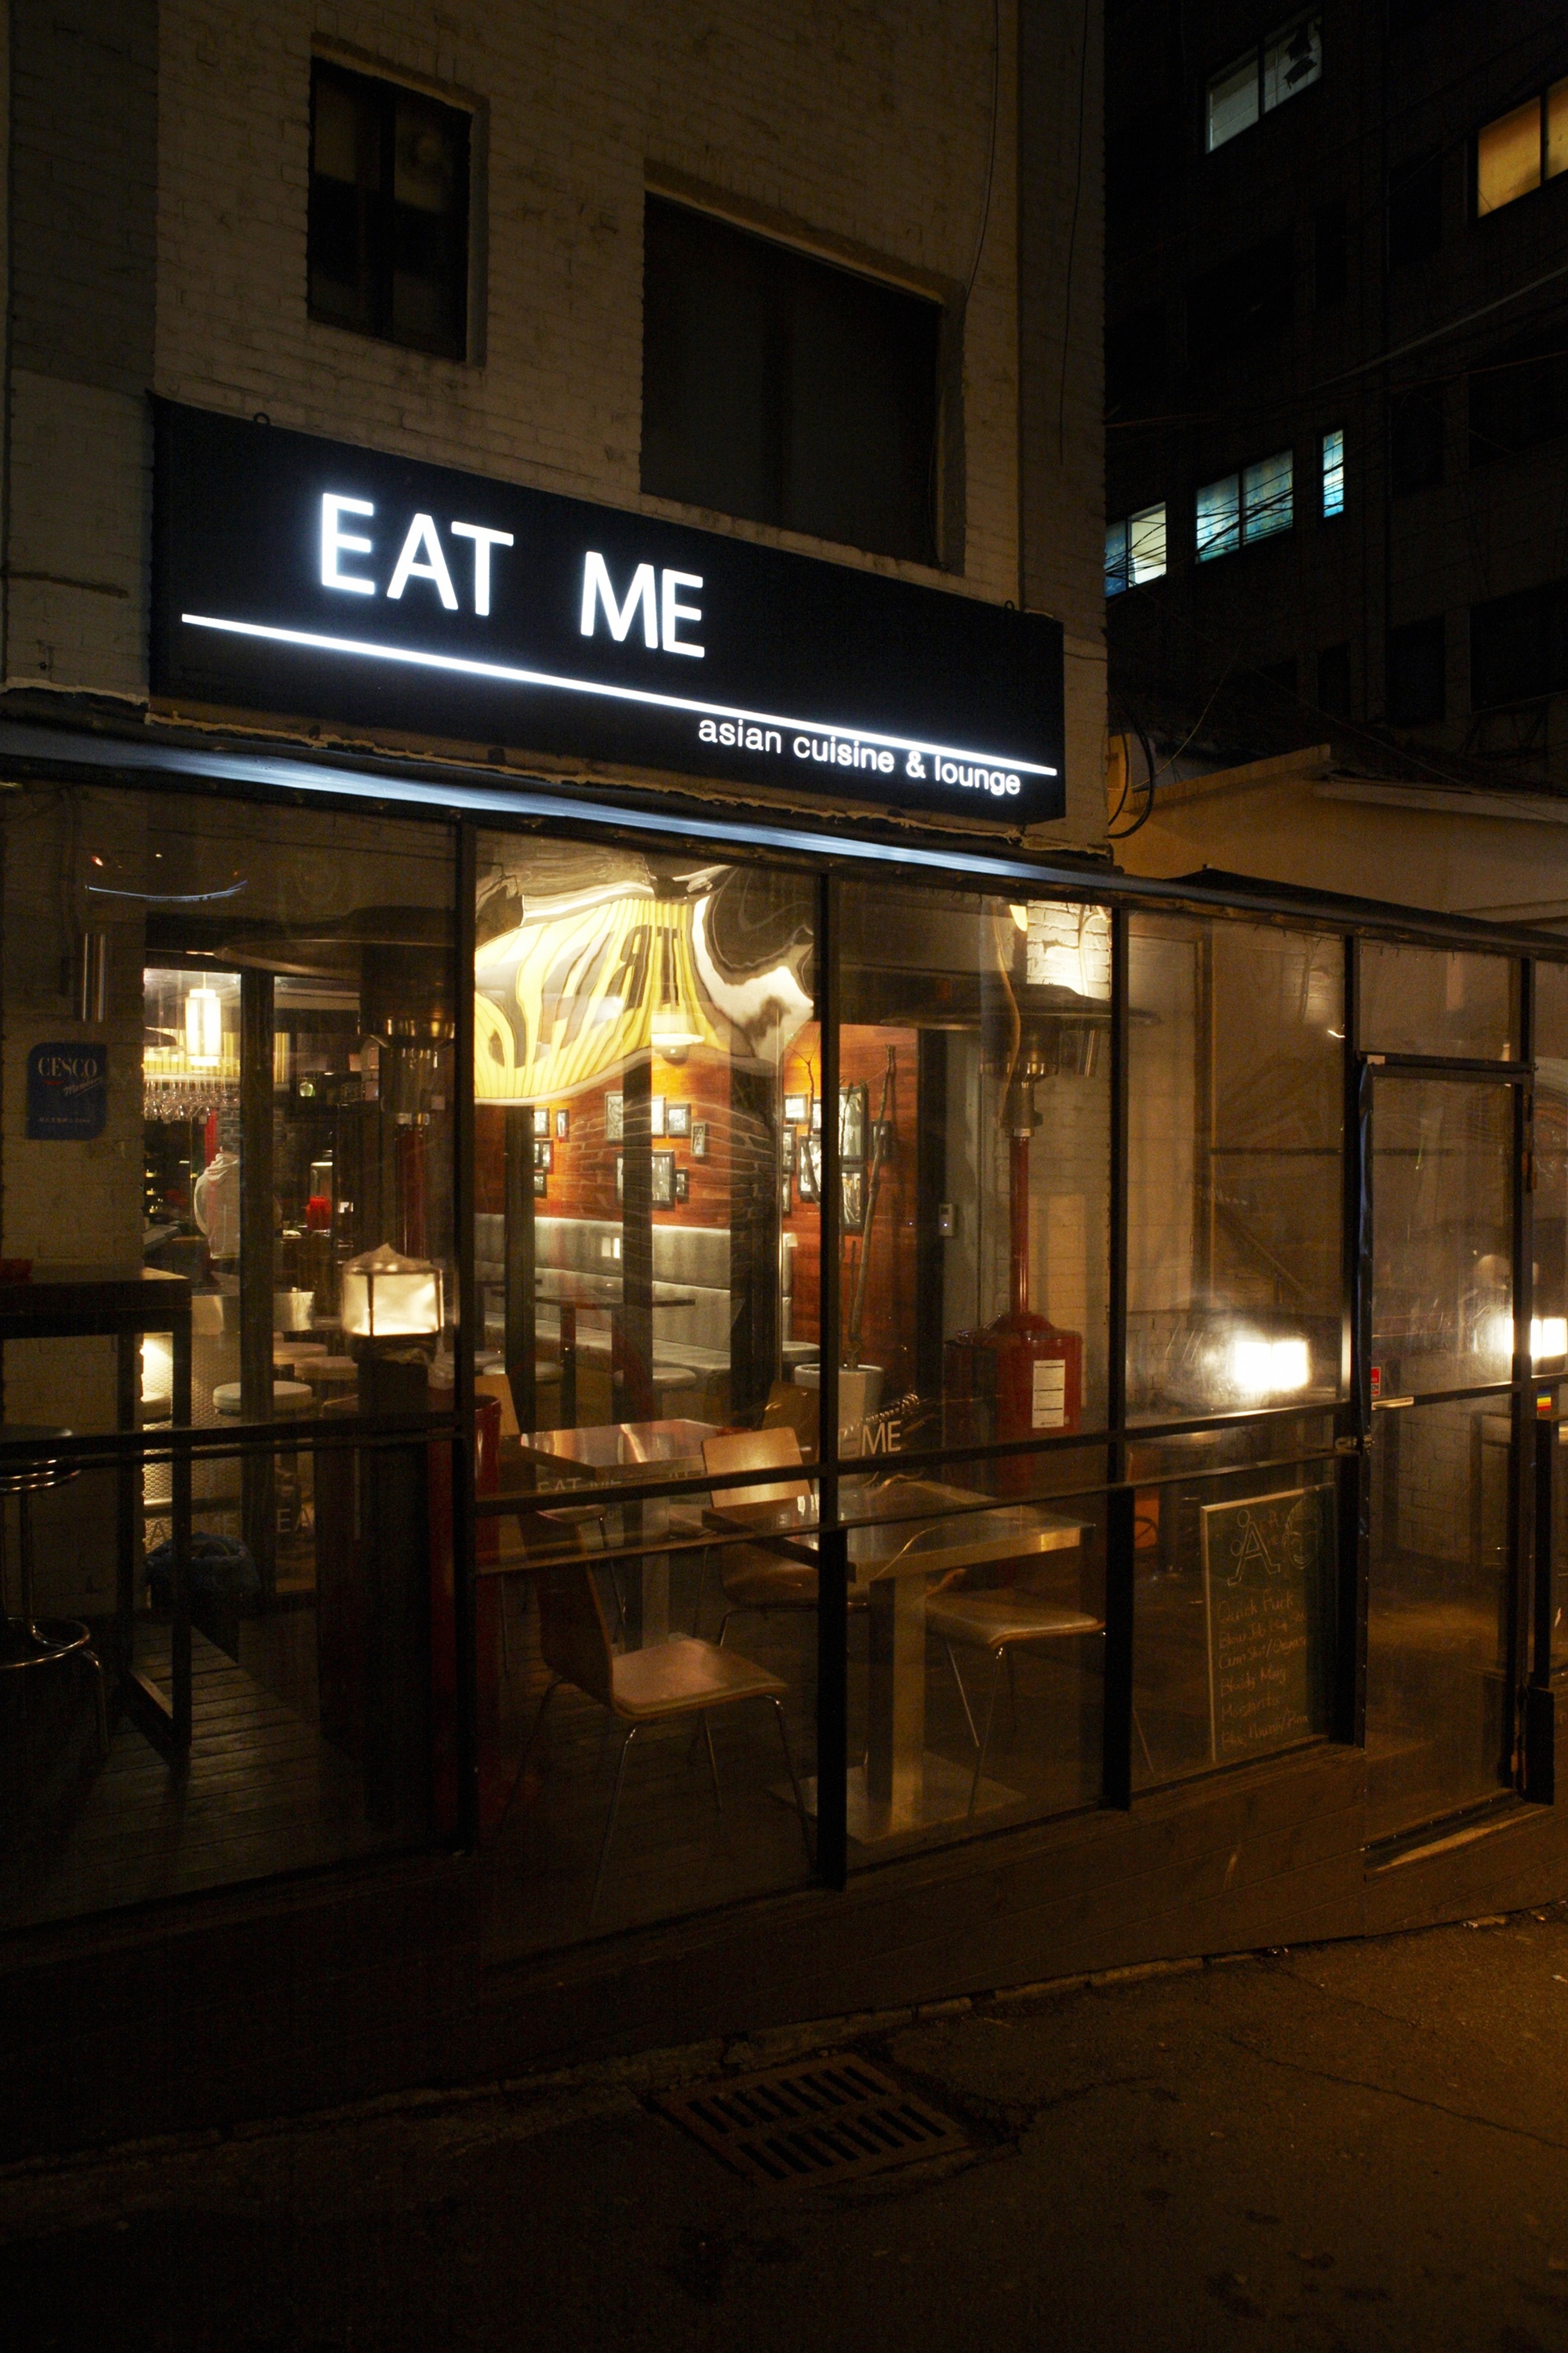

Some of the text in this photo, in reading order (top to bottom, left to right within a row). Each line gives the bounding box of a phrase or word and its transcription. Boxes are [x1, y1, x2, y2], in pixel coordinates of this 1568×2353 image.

[318, 492, 705, 658] EAT ME
[697, 718, 1021, 796] asian cuisine & lounge
[38, 1056, 98, 1078] CESCO
[861, 1420, 902, 1457] ME
